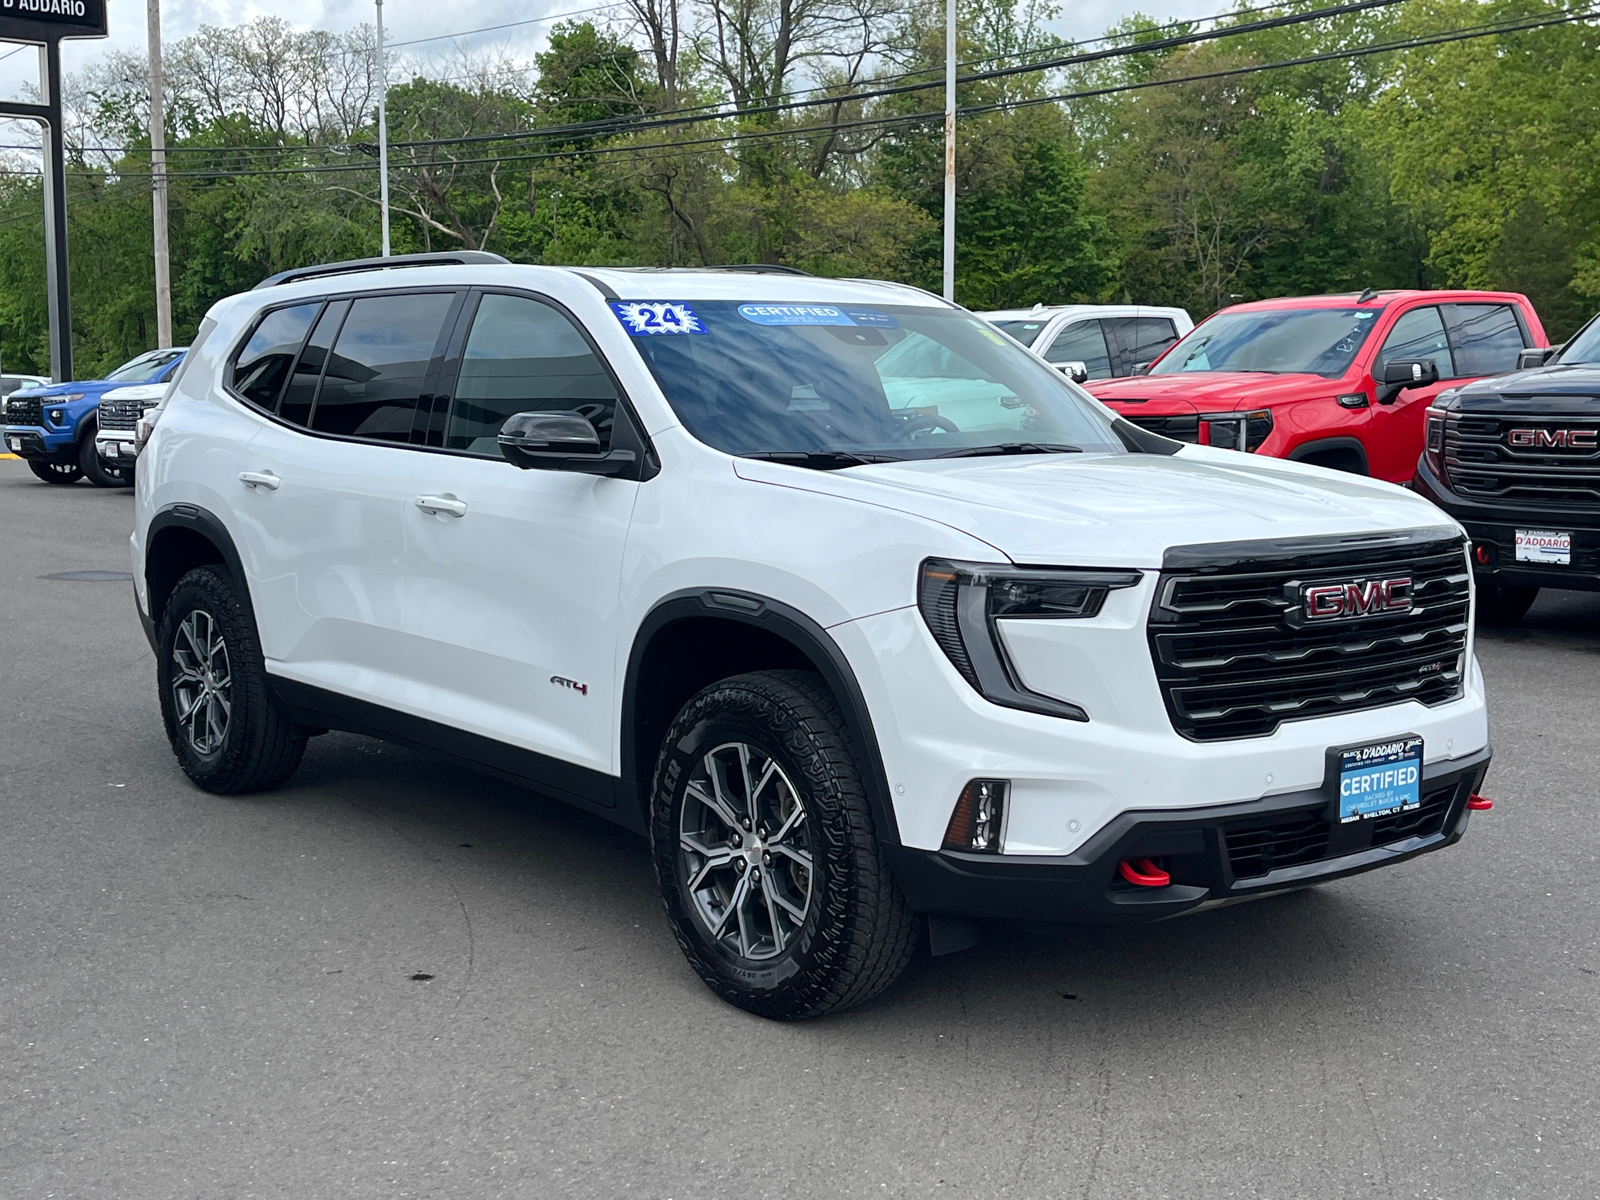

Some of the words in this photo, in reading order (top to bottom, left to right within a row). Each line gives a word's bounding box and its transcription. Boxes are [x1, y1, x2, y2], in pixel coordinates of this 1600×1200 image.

[3, 0, 86, 17] DADDARIO
[638, 307, 682, 328] 24
[742, 306, 839, 317] CERTIFIED
[1508, 429, 1599, 449] GMC
[1515, 536, 1570, 548] D'ADDARIO
[1306, 577, 1412, 619] GMC
[550, 675, 588, 697] AT4
[1362, 742, 1405, 760] D'ADDARIO
[1340, 766, 1418, 797] CERTIFIED
[1364, 791, 1386, 802] BACKED
[1386, 790, 1394, 798] BY
[1363, 808, 1392, 819] SHELTON,
